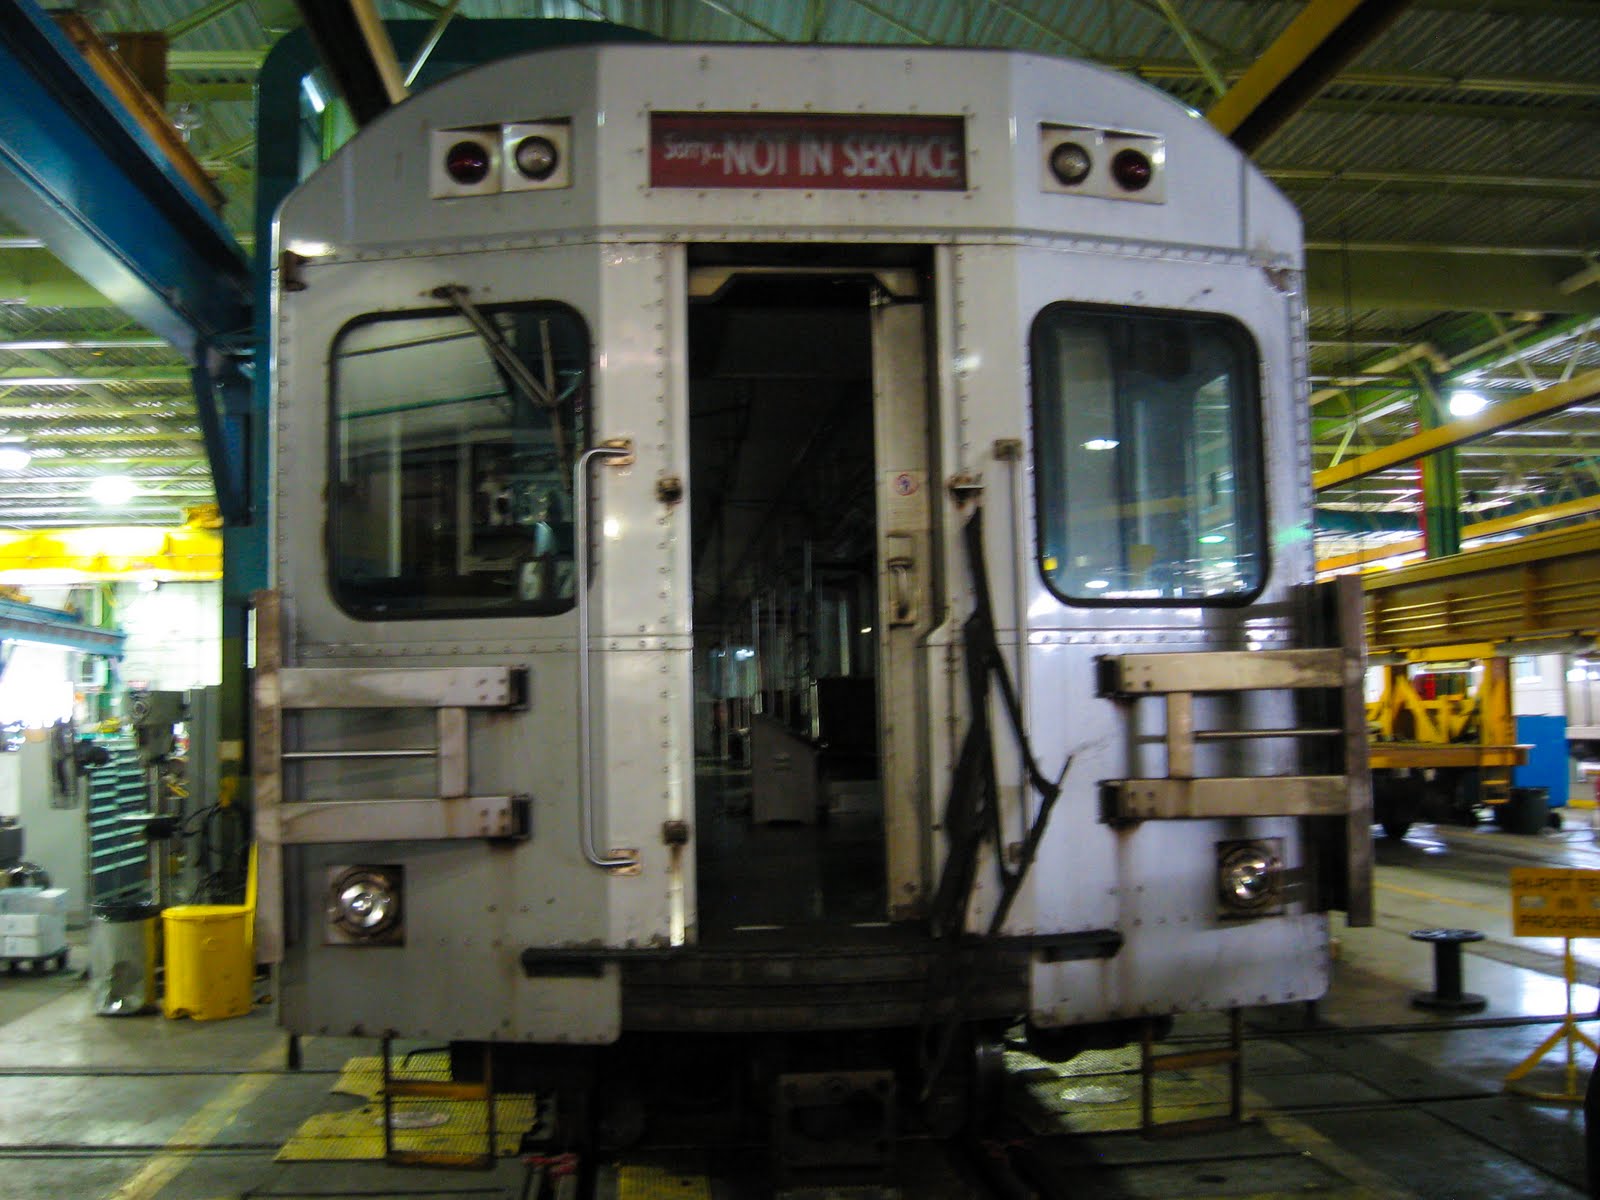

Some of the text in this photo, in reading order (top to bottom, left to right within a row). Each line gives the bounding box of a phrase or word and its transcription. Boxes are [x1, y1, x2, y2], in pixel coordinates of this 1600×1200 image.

[723, 132, 789, 176] NOT
[799, 132, 833, 176] IN
[841, 134, 960, 178] SERVICE
